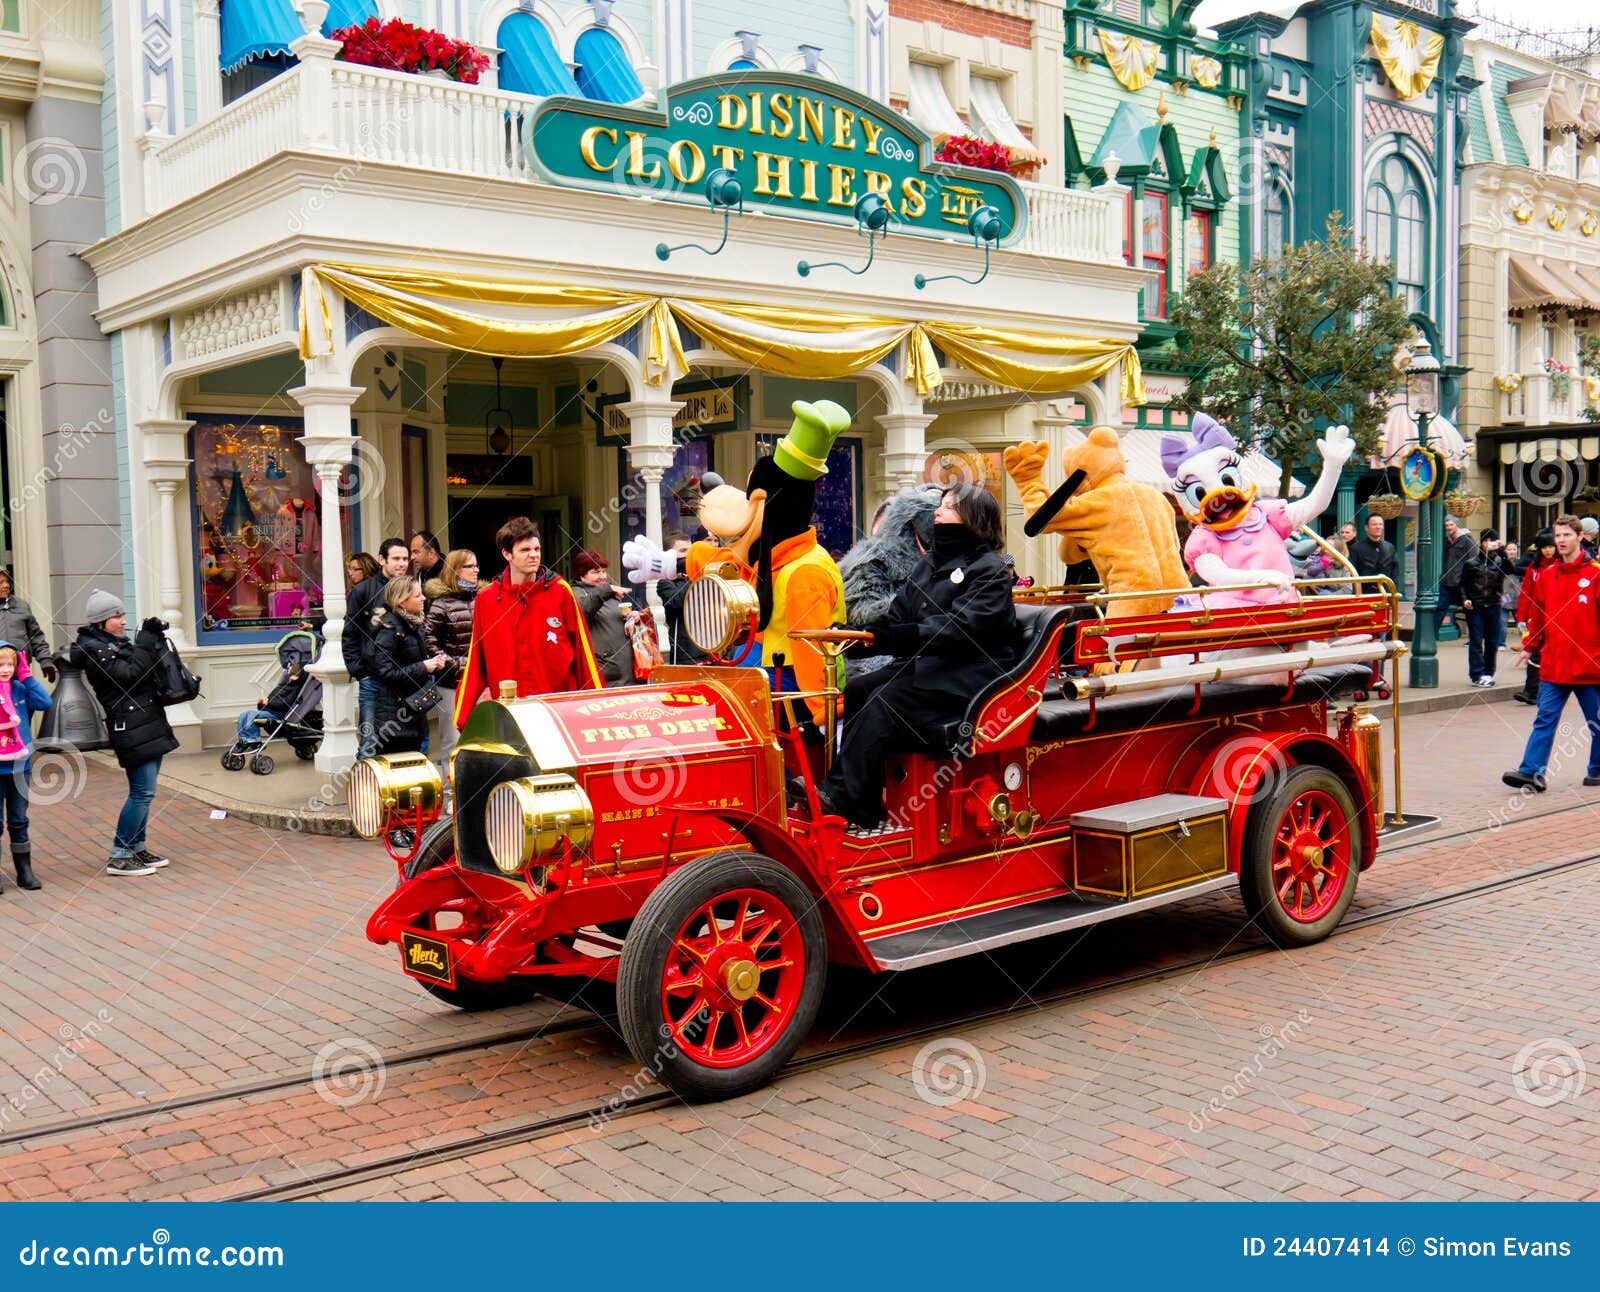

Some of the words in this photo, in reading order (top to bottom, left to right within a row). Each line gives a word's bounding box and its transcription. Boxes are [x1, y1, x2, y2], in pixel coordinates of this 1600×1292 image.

[717, 91, 884, 155] DISNEY
[580, 126, 926, 218] CLOTHIERS
[581, 723, 652, 743] FIRE
[658, 716, 733, 737] DEPT.
[601, 809, 642, 823] MAIN
[409, 943, 441, 967] Hertz
